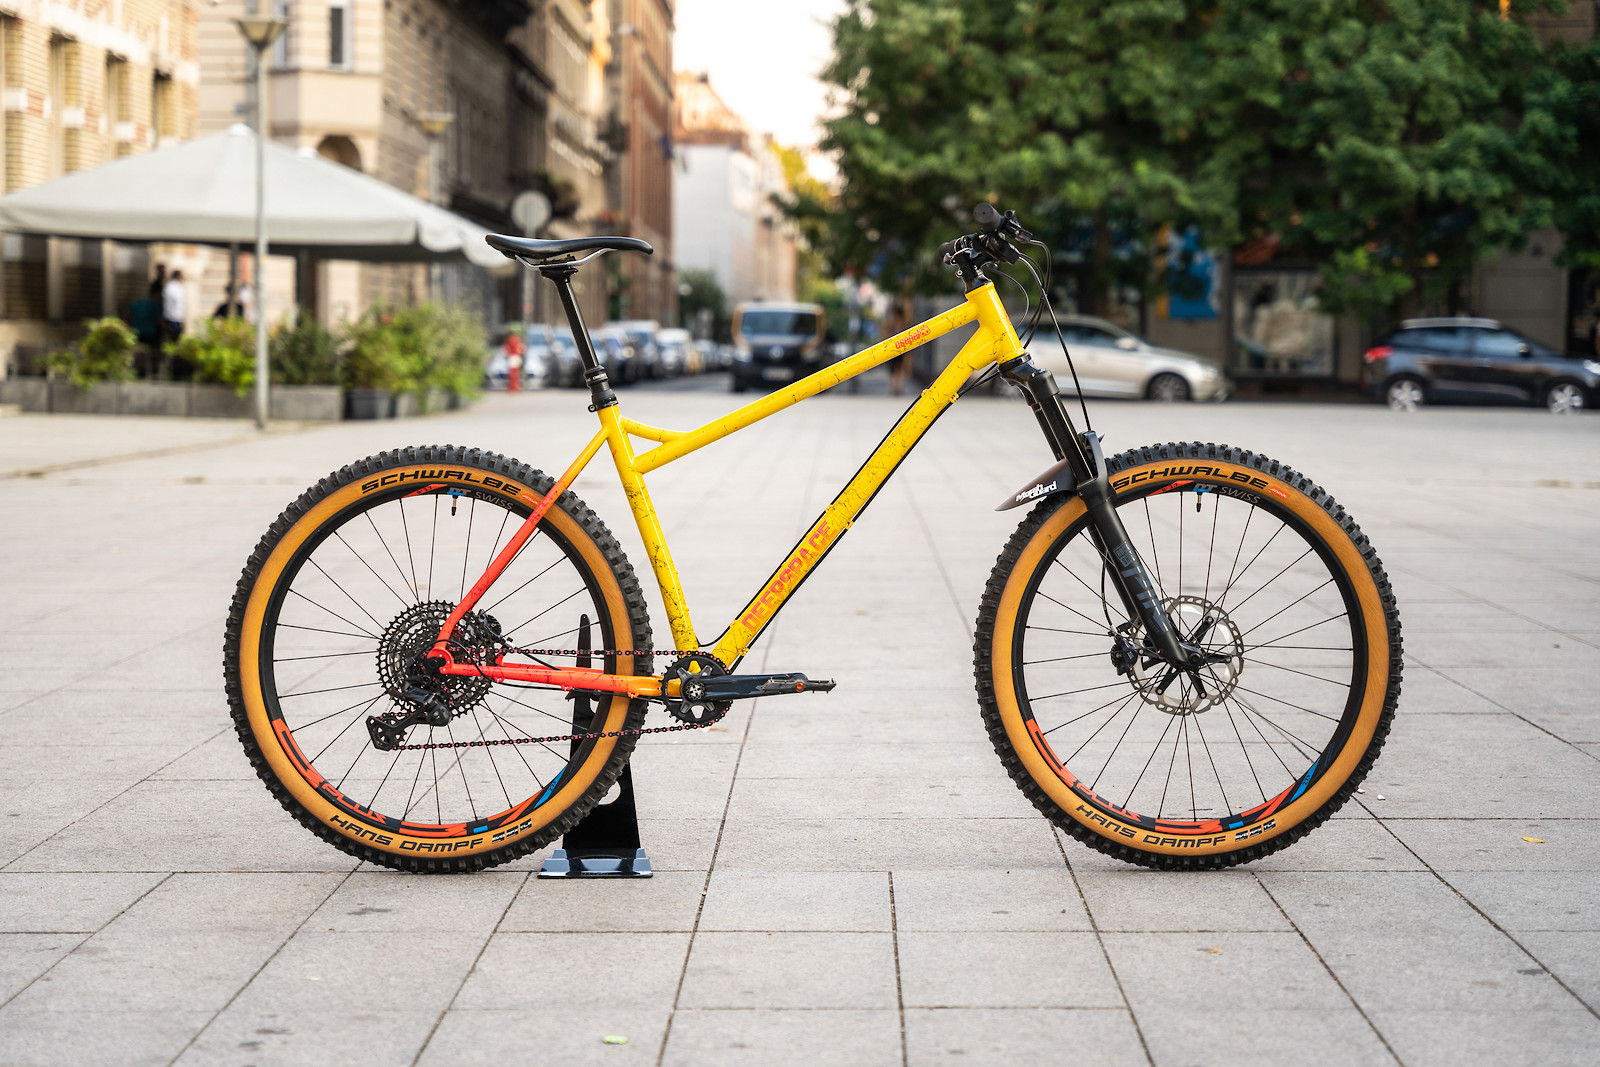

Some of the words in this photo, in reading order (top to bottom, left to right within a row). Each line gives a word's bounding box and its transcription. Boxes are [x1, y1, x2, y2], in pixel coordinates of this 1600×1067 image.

[361, 469, 521, 495] SCHWALBE
[1112, 466, 1269, 490] SCHWALBE
[1194, 483, 1218, 492] DT
[1219, 486, 1261, 504] SWISS
[475, 491, 514, 510] SWISS
[321, 782, 387, 824] PLUS
[1076, 782, 1141, 822] PLUS
[330, 814, 393, 846] HANS
[399, 837, 483, 852] DAMPF
[1076, 804, 1137, 838] HANS
[1143, 834, 1226, 848] DAMPF
